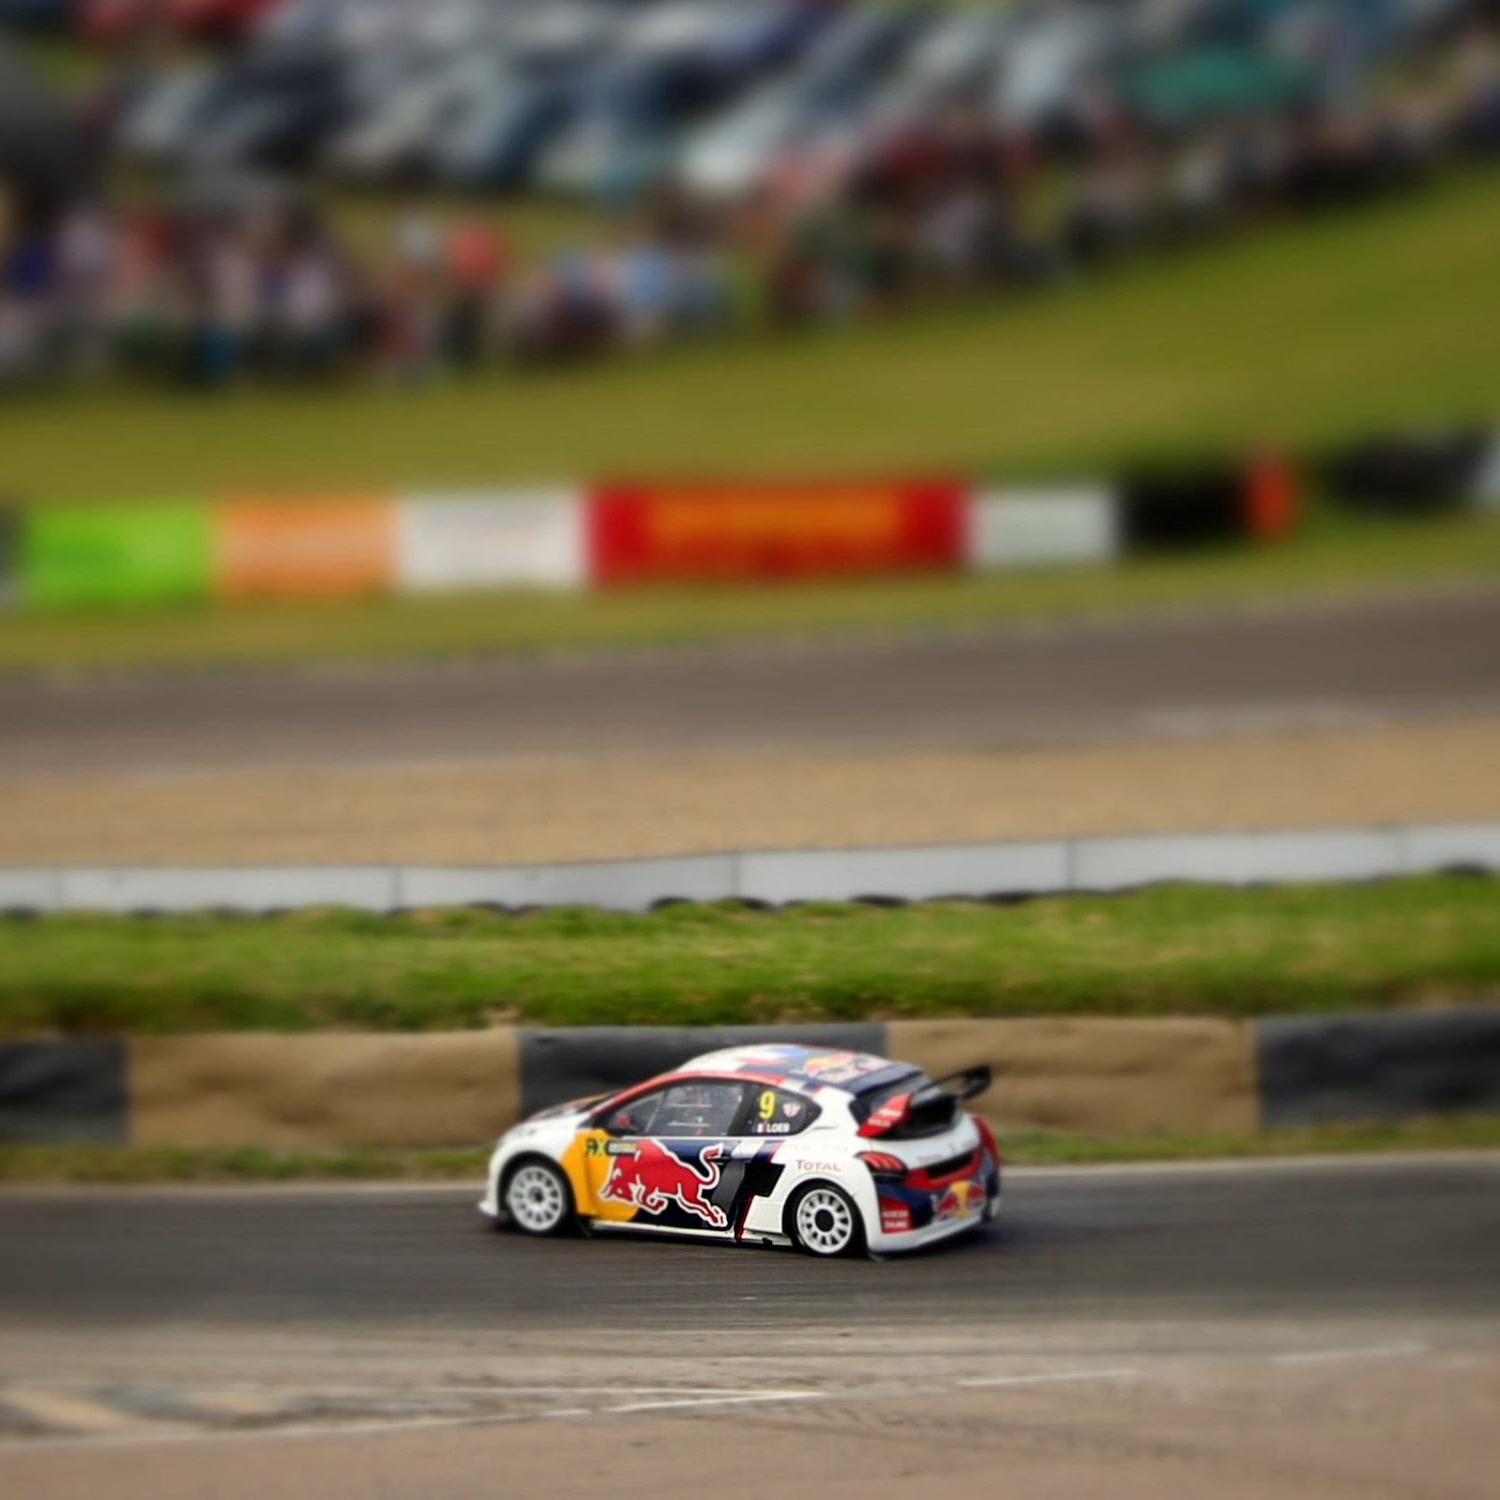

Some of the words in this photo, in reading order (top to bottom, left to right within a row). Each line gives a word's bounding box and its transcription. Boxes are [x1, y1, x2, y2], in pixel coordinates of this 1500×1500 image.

[759, 1091, 775, 1119] 9
[767, 1122, 790, 1133] LOEB
[796, 1160, 841, 1171] TOTAL
